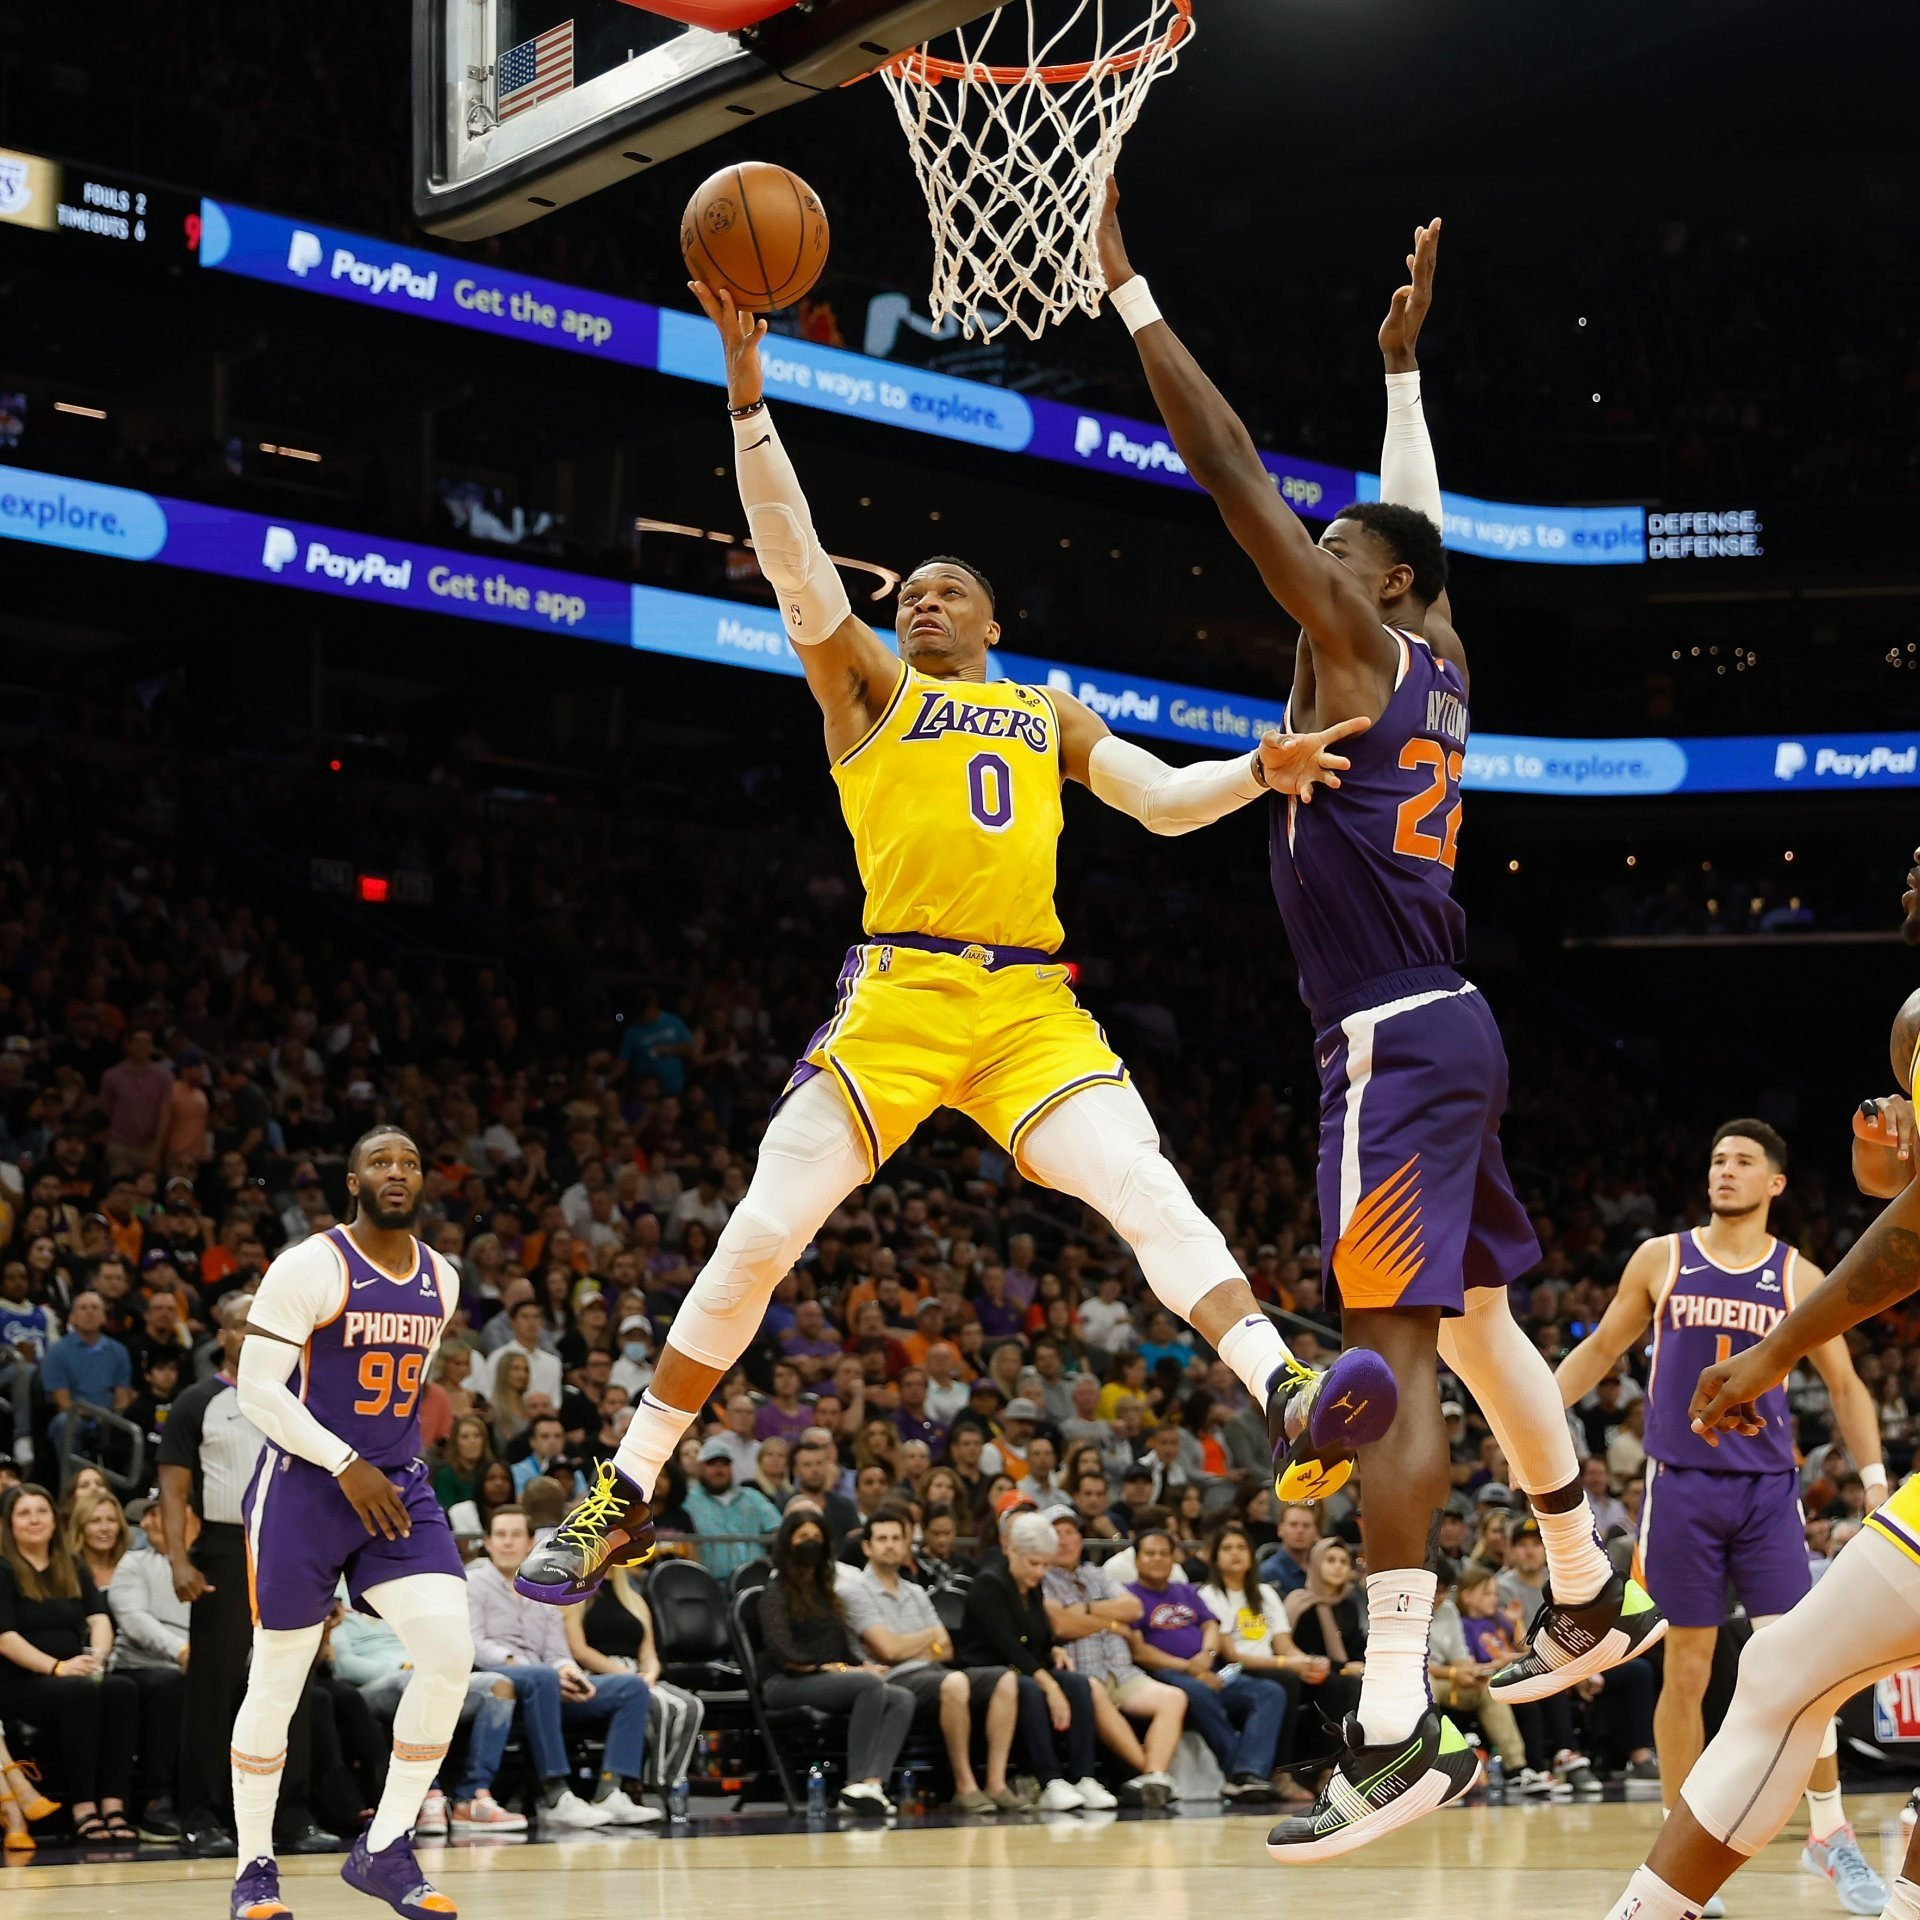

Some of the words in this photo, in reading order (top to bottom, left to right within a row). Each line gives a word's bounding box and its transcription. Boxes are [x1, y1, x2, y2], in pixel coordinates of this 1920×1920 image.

[83, 182, 130, 213] FOULS
[135, 193, 147, 216] 2
[56, 203, 129, 240] TIMEOUTS
[134, 220, 146, 242] 6
[331, 249, 437, 301] PayPal
[453, 279, 504, 316] Get
[509, 291, 556, 328] the
[561, 309, 612, 346] app
[815, 369, 875, 405] ways
[880, 381, 907, 409] to
[1107, 431, 1187, 471] PayPa
[1282, 475, 1323, 508] app
[1, 493, 126, 538] explore.
[1443, 512, 1473, 539] ore
[1475, 519, 1533, 550] ways
[1536, 523, 1566, 548] to
[305, 542, 411, 591] PayPal
[428, 566, 478, 601] Get
[483, 574, 531, 611] the
[535, 589, 586, 626] app
[716, 618, 783, 655] More
[900, 693, 1049, 753] LAKERS
[1079, 683, 1159, 722] PayPal
[1169, 699, 1211, 732] Get
[1212, 704, 1250, 738] the
[1425, 690, 1467, 744] AYTON
[1514, 753, 1543, 778] to
[1815, 745, 1917, 779] PayPal
[967, 752, 1015, 833] 0
[343, 1311, 442, 1350] PHOENIX
[1669, 1295, 1787, 1338] PHOENIX
[354, 1351, 424, 1417] 99
